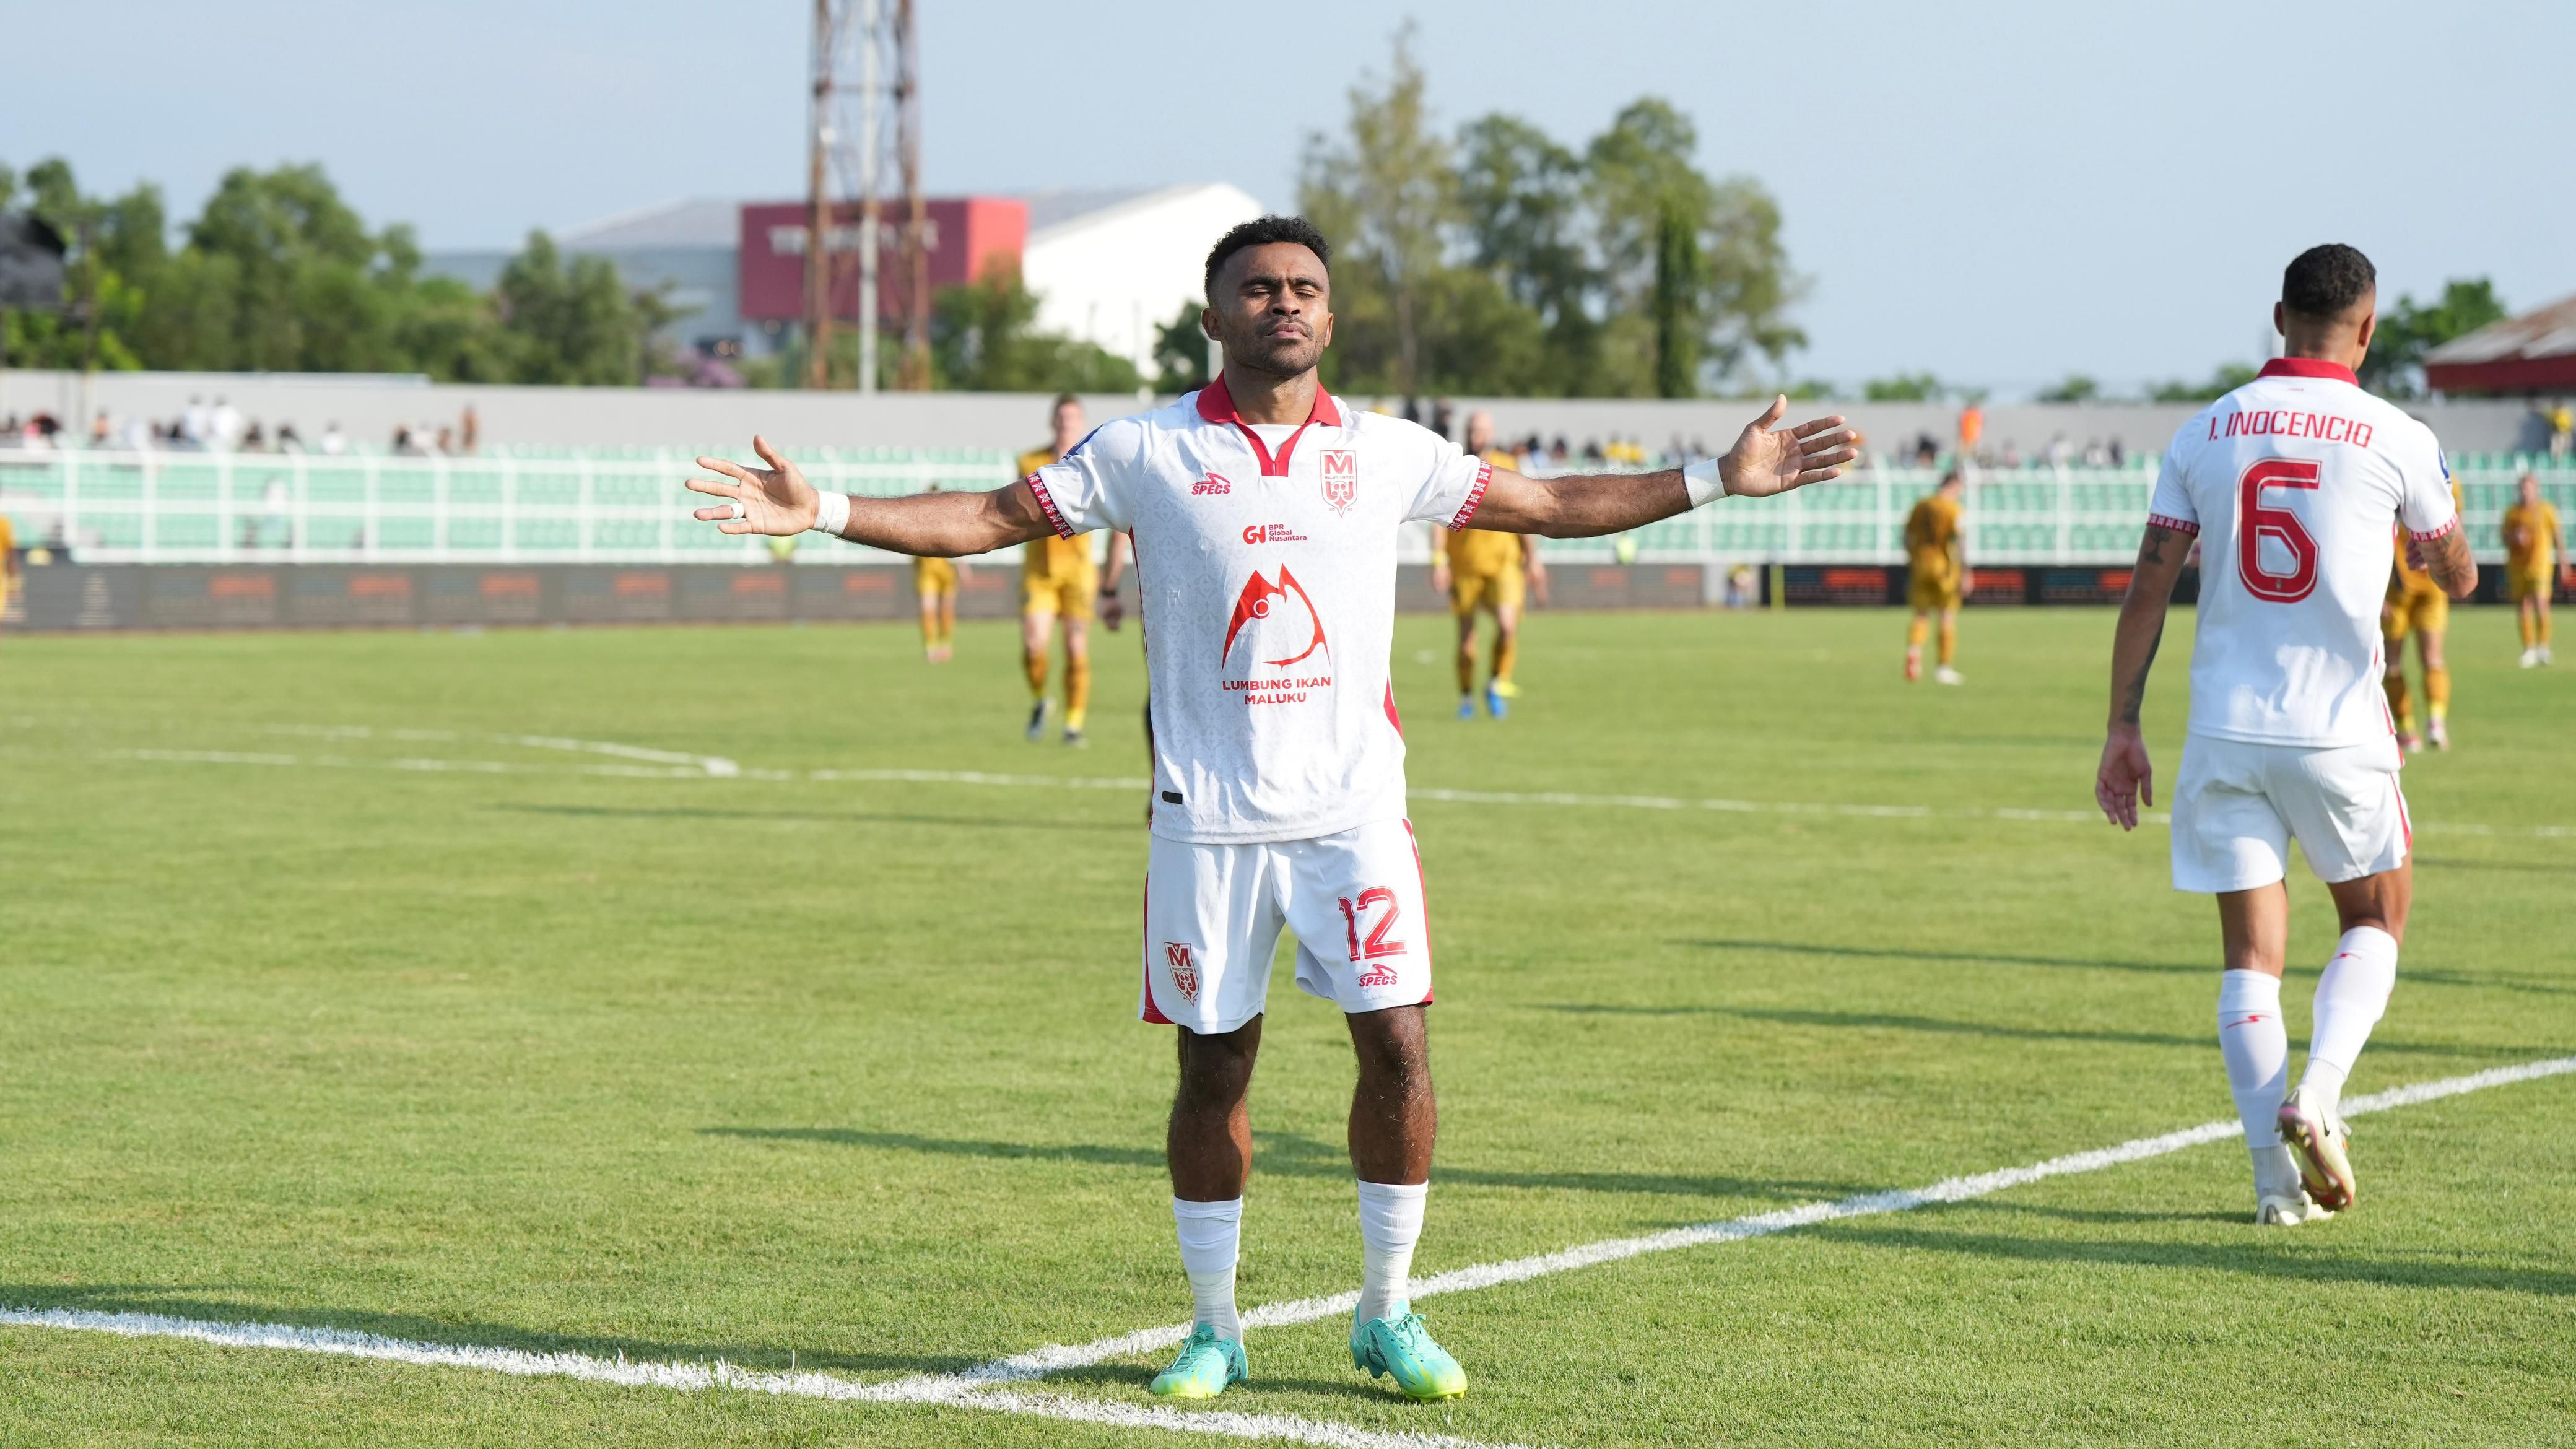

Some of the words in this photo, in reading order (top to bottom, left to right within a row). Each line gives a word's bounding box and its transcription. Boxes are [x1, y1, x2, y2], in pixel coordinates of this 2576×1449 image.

[2225, 411, 2373, 448] INOCENCIO
[1324, 455, 1353, 474] M
[1191, 484, 1230, 495] SPECS
[2237, 457, 2322, 604] 6
[1222, 679, 1292, 690] LUMBUNG
[1297, 677, 1331, 688] IKAN
[1245, 692, 1306, 705] MALUKU
[1338, 886, 1408, 962] 12
[1167, 947, 1191, 967] M
[1359, 975, 1398, 987] SPECS
